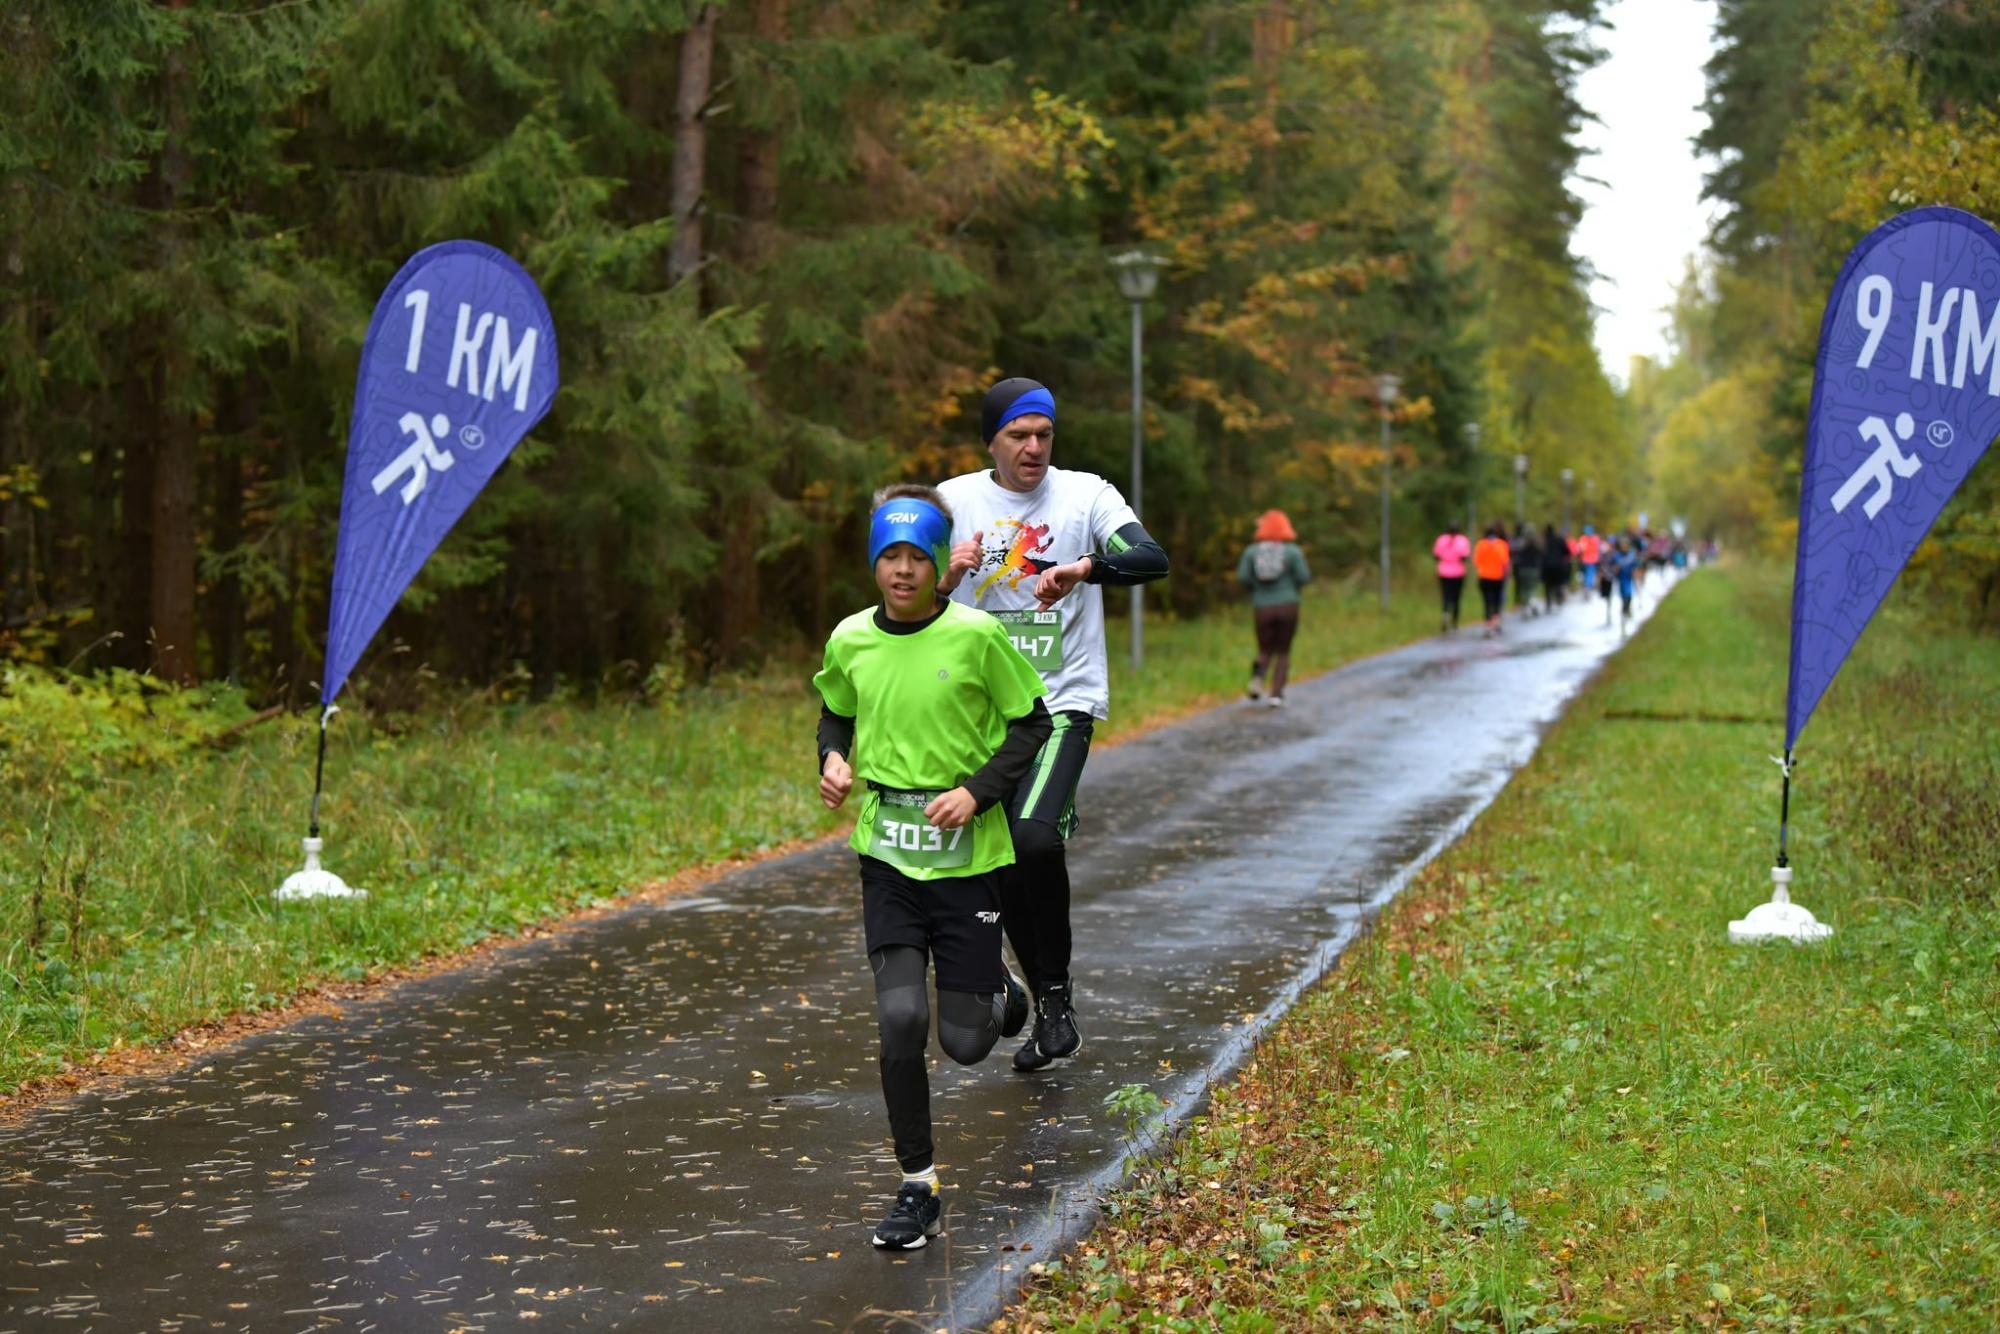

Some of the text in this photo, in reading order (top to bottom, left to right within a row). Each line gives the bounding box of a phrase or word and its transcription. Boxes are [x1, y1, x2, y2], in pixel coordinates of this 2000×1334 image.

[405, 289, 429, 373] 1
[1857, 275, 1893, 369] 9
[884, 512, 919, 524] RAY
[880, 820, 963, 851] 3037
